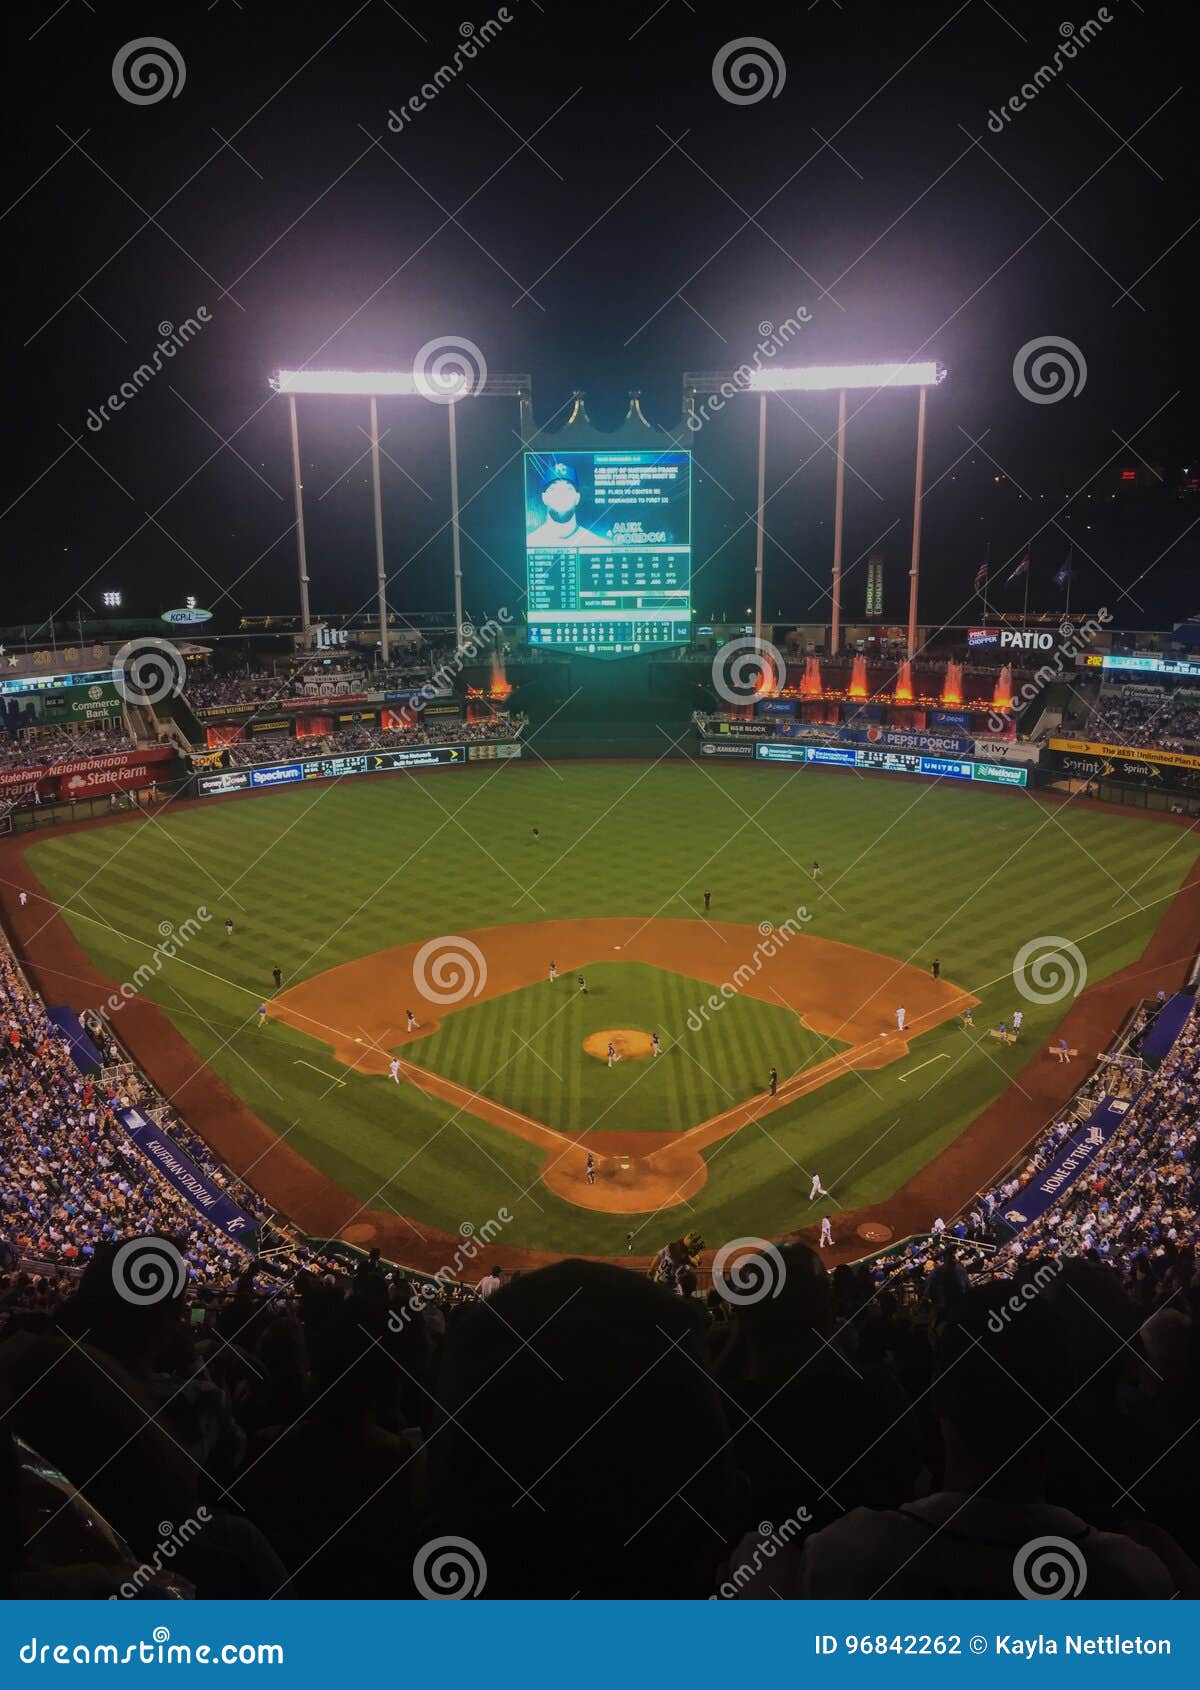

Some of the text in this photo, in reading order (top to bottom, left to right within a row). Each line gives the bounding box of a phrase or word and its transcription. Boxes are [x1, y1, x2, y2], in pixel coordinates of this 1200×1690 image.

[316, 627, 348, 649] Lite
[1000, 631, 1053, 650] PATIO
[72, 699, 120, 711] Commerce
[86, 709, 109, 718] Bank
[887, 734, 960, 750] PEPSI PORCH
[992, 744, 1009, 754] Ivy
[49, 756, 128, 776] NEIGHBORHOOD
[988, 768, 1021, 779] National
[1064, 757, 1100, 774] Sprint
[1123, 764, 1148, 775] Sprint
[254, 769, 298, 783] Spectrum
[146, 1140, 215, 1207] KAUFFMAN STADIUM
[1040, 1143, 1093, 1194] HOME OF THE
